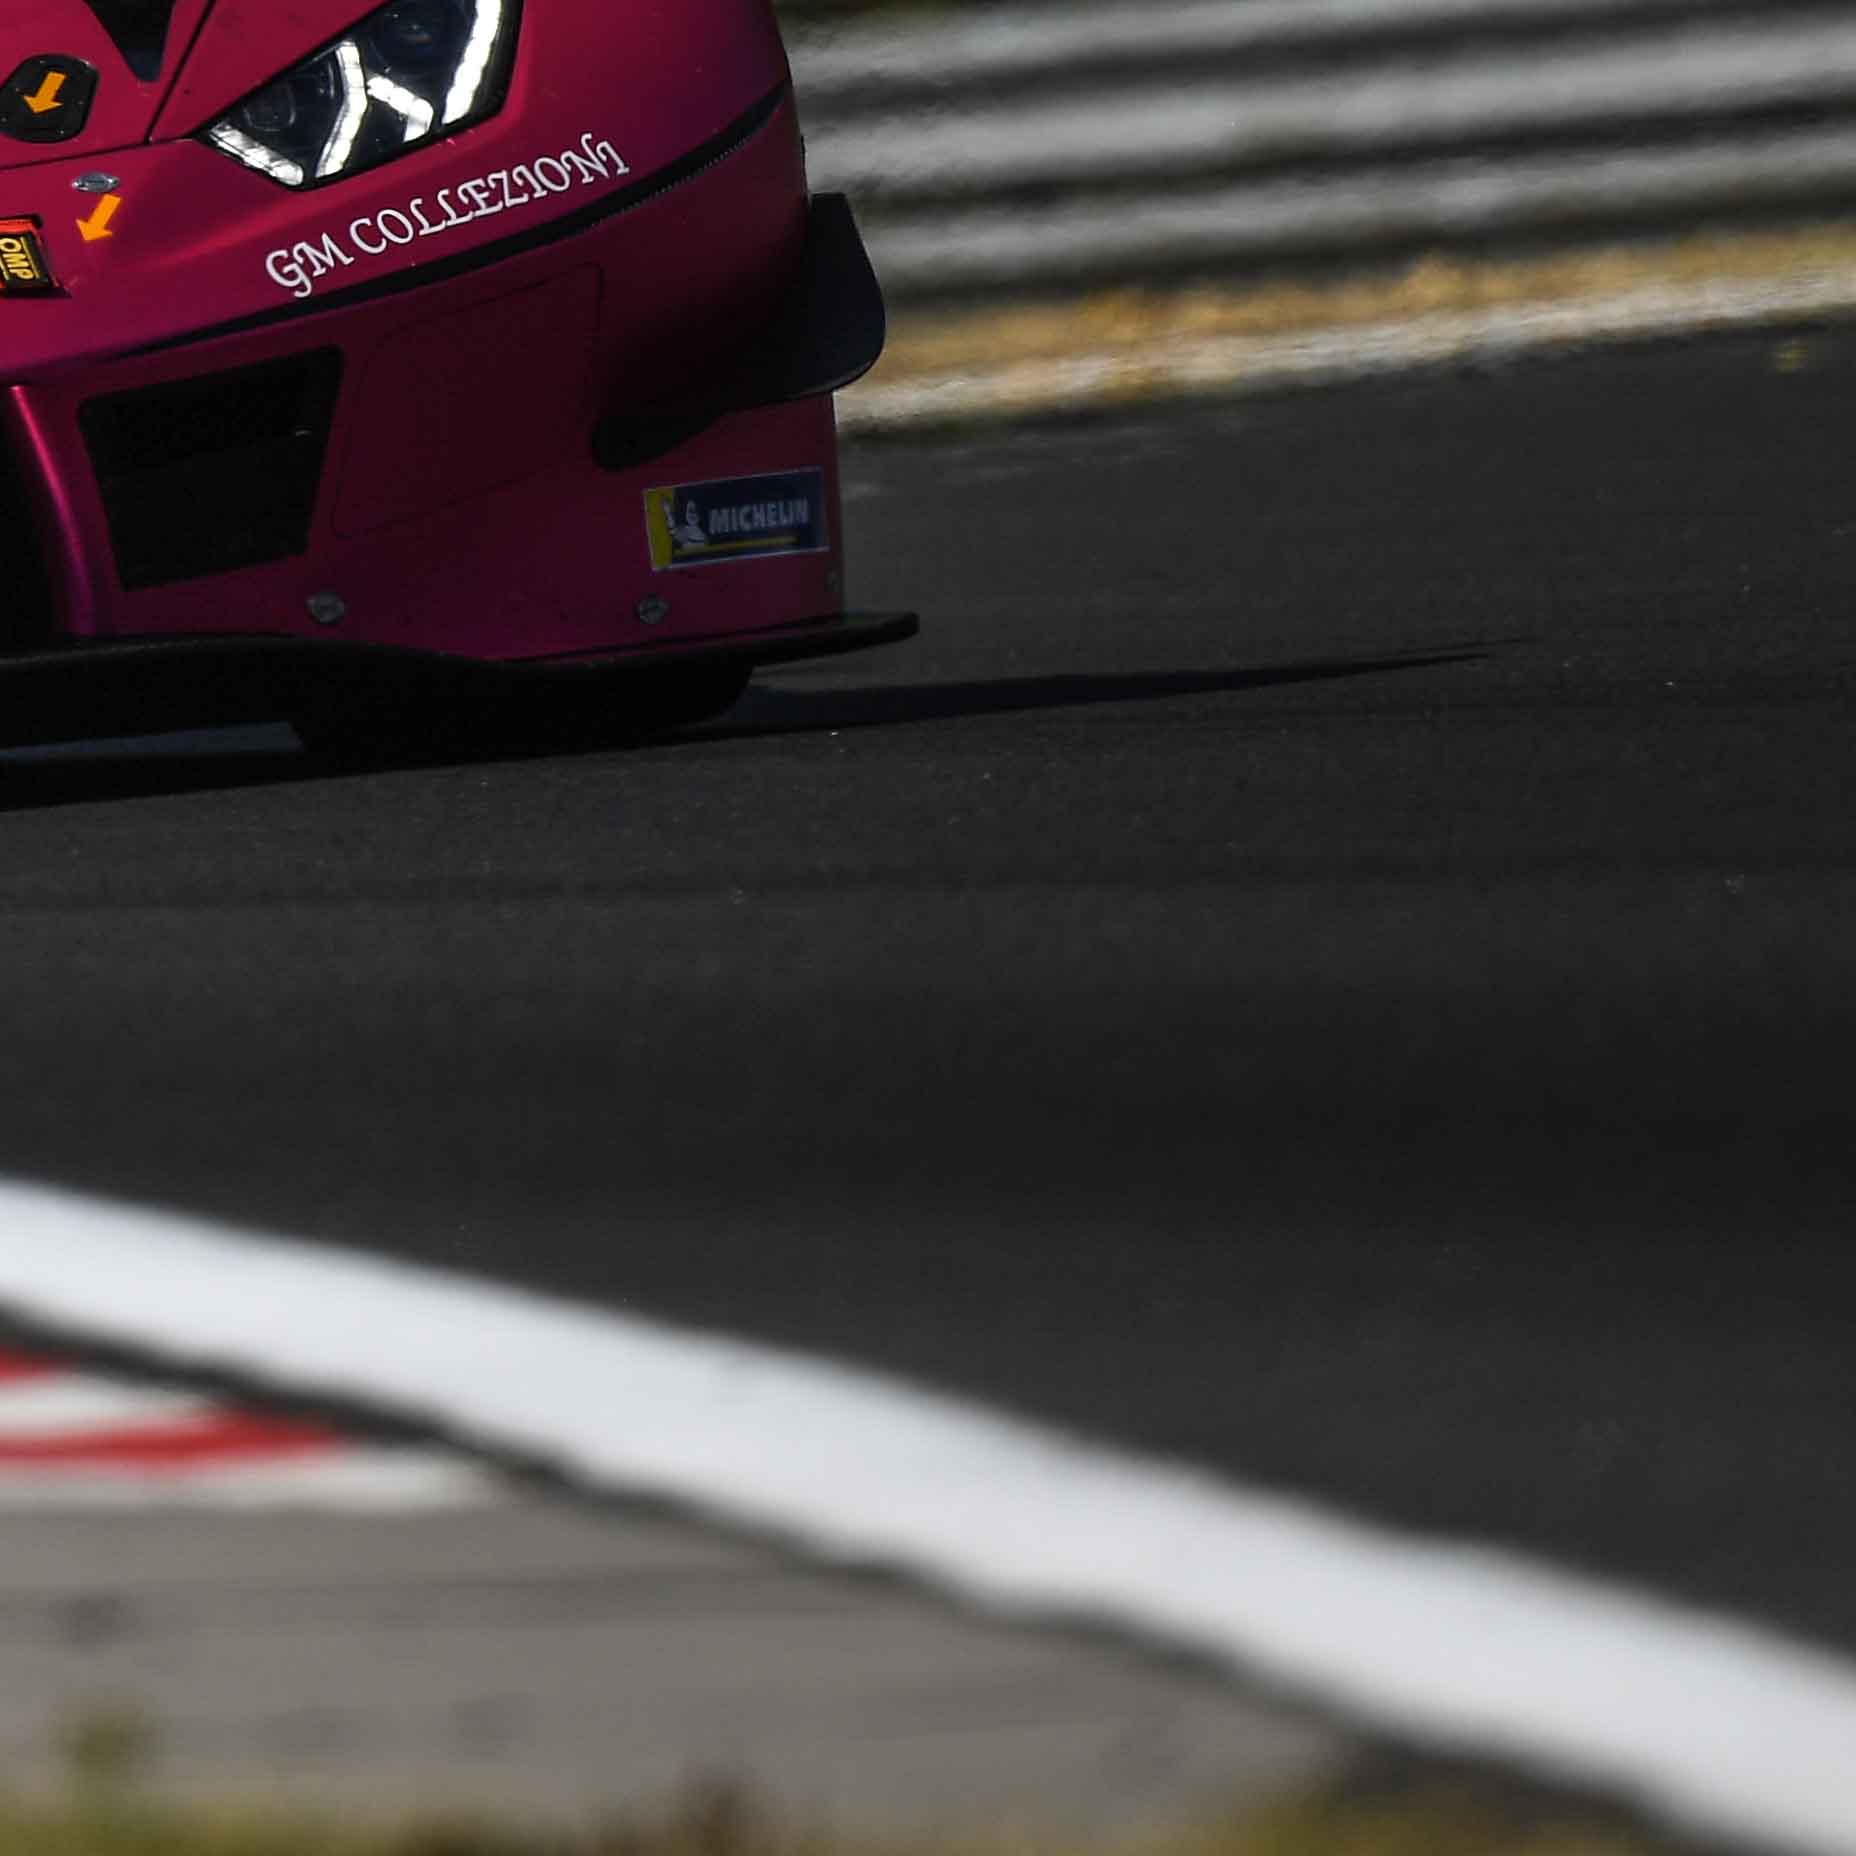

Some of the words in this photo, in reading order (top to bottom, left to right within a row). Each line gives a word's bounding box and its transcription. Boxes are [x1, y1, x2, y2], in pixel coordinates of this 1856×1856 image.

[265, 233, 355, 298] GM
[349, 133, 630, 254] COLLEZIONI
[708, 497, 809, 534] MICHELIN
